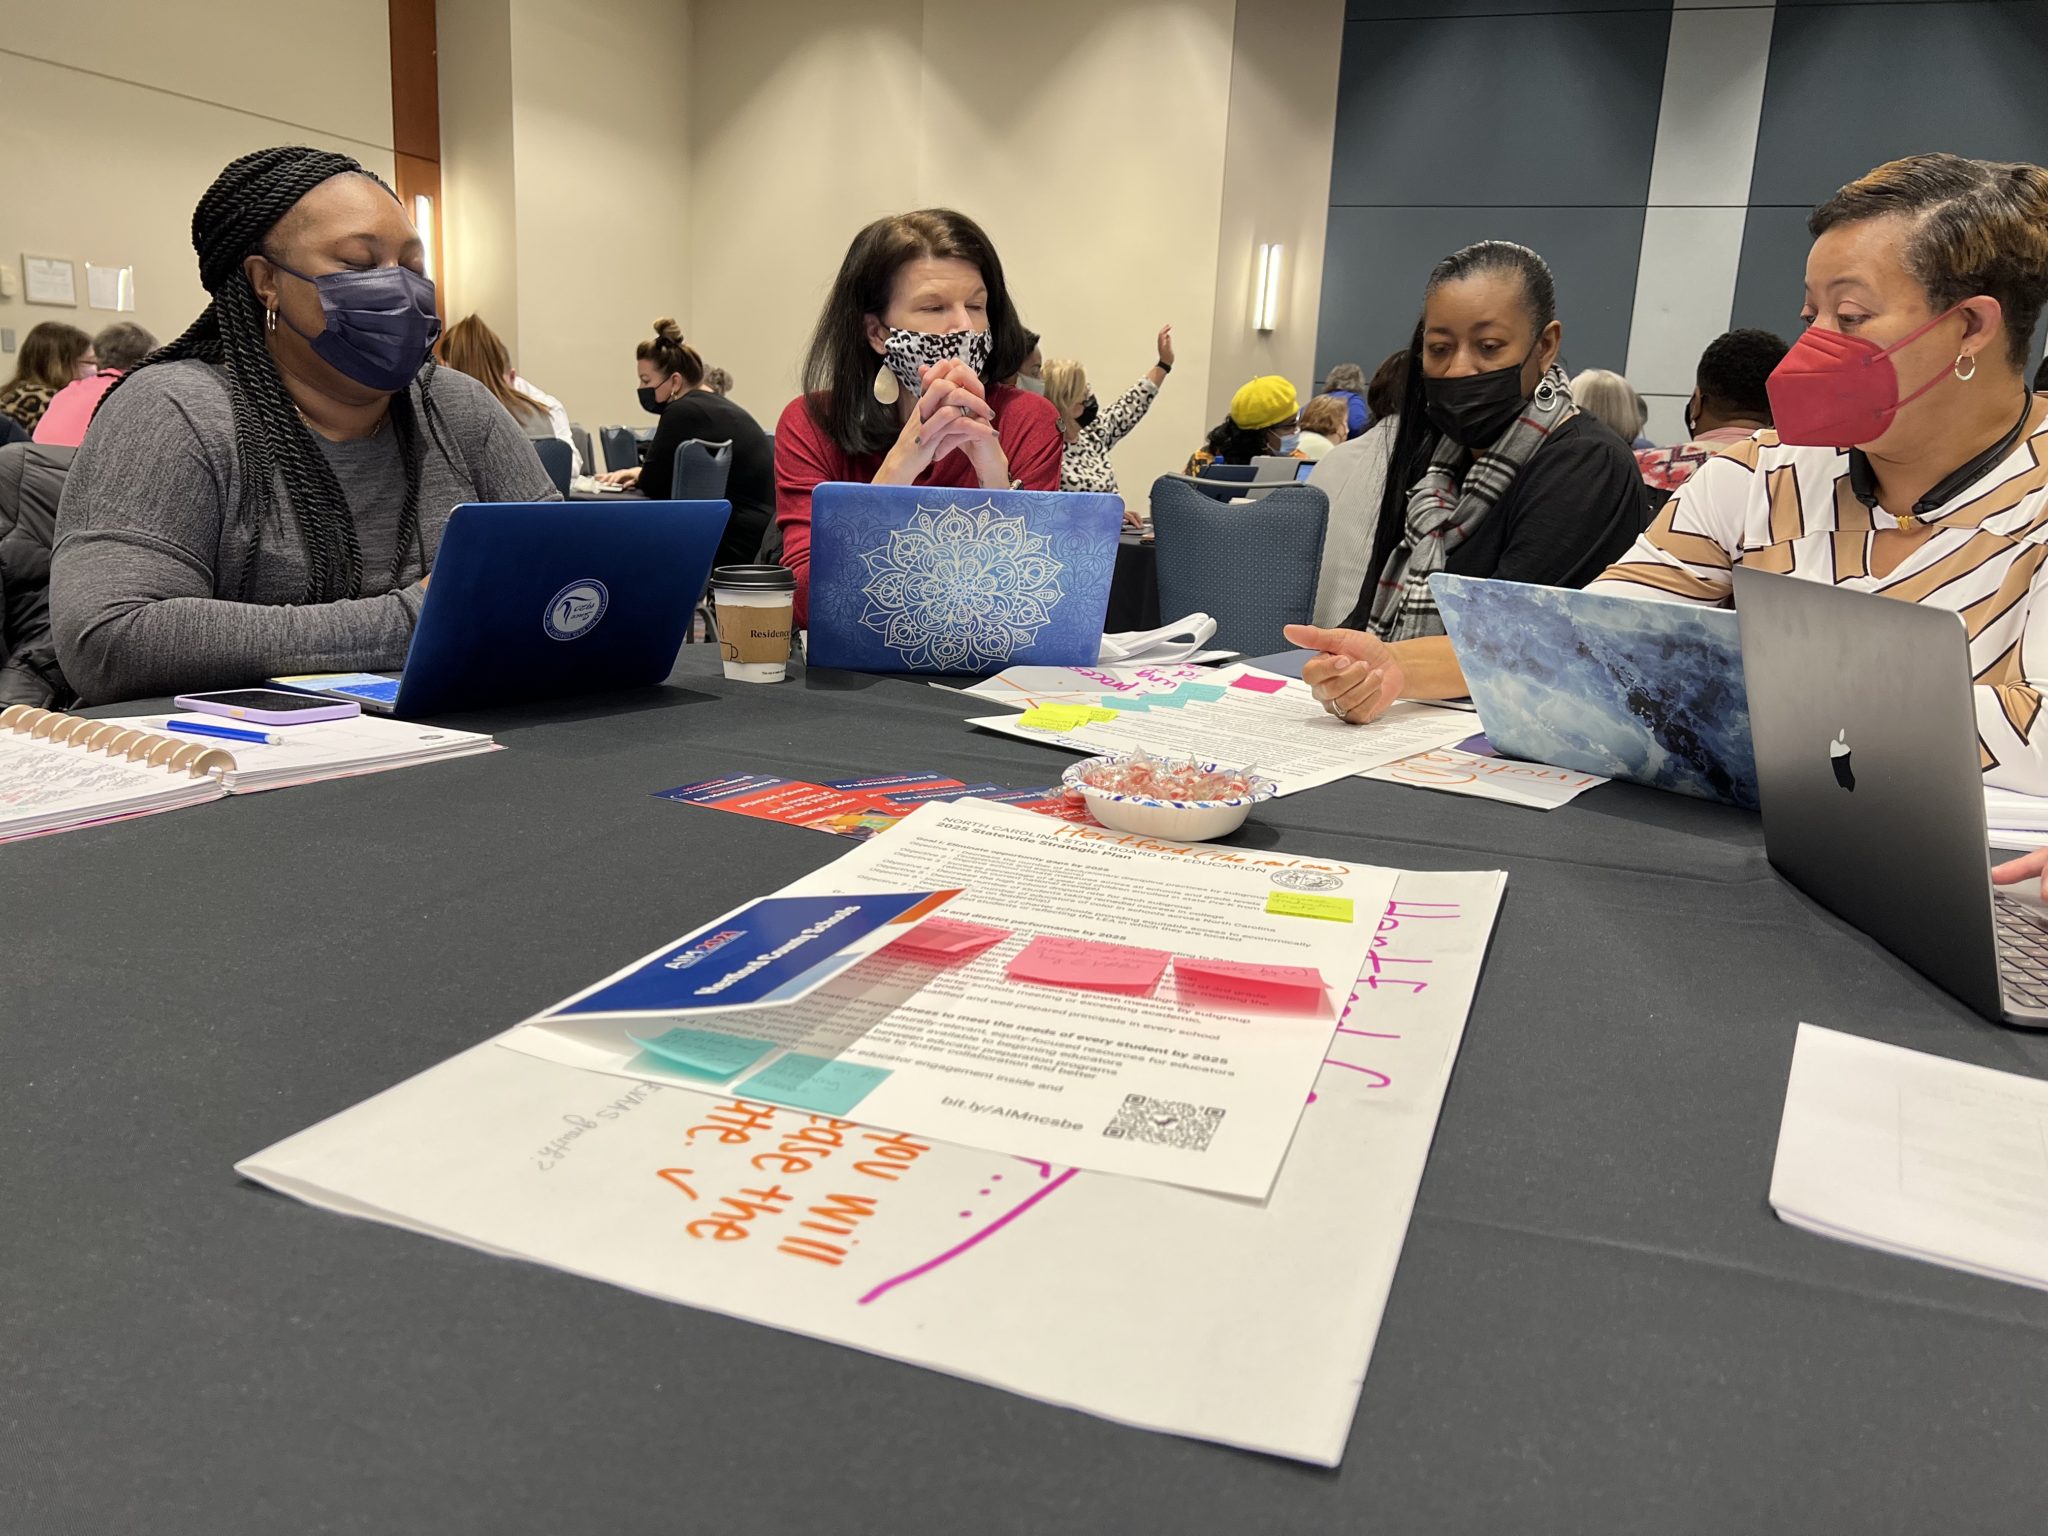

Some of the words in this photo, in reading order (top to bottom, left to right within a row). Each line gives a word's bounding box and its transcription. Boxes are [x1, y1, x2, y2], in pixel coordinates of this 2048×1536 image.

[933, 822, 970, 831] 2025
[969, 828, 1037, 843] Statewide
[1036, 840, 1100, 854] Strategic
[1100, 851, 1134, 859] Plan
[940, 817, 991, 828] NORTH
[989, 825, 1062, 841] CAROLINA
[1061, 838, 1107, 849] STATE
[1107, 846, 1158, 857] BOARD
[1182, 858, 1267, 872] EDUCATION
[1053, 824, 1195, 857] Hertford
[970, 913, 1010, 922] district
[1009, 919, 1081, 933] performance
[1097, 932, 1128, 940] 2025
[664, 949, 704, 970] AIM
[693, 958, 771, 996] Hertford
[757, 934, 819, 962] County
[801, 905, 862, 935] Schools
[850, 997, 941, 1016] preparedness
[954, 1014, 991, 1024] meet
[991, 1020, 1016, 1029] the
[1014, 1024, 1057, 1036] needs
[1057, 1031, 1075, 1039] of
[1074, 1034, 1114, 1046] every
[1115, 1041, 1169, 1054] student
[1170, 1050, 1190, 1058] by
[1191, 1053, 1229, 1065] 2025
[965, 994, 990, 1002] and
[1067, 1011, 1127, 1025] principals
[1141, 1023, 1177, 1033] every
[1176, 1029, 1221, 1040] school
[872, 1028, 926, 1041] between
[923, 1037, 981, 1051] educator
[980, 1046, 1055, 1065] preparation
[1054, 1059, 1119, 1076] programs
[906, 1041, 947, 1052] foster
[945, 1048, 1030, 1067] collaboration
[1030, 1063, 1057, 1072] and
[1056, 1067, 1098, 1080] better
[924, 1028, 981, 1042] available
[994, 1040, 1058, 1056] beginning
[1058, 1051, 1124, 1067] educators
[1082, 1045, 1147, 1061] resources
[1147, 1056, 1168, 1065] for
[1168, 1060, 1236, 1077] educators
[855, 1049, 914, 1064] educator
[911, 1059, 995, 1079] engagement
[994, 1074, 1038, 1087] inside
[1036, 1082, 1065, 1092] and
[937, 1096, 1087, 1132] bit.ly/AIMncsbe
[851, 1130, 932, 1182] you
[684, 1184, 796, 1242] the
[775, 1192, 880, 1267] will
